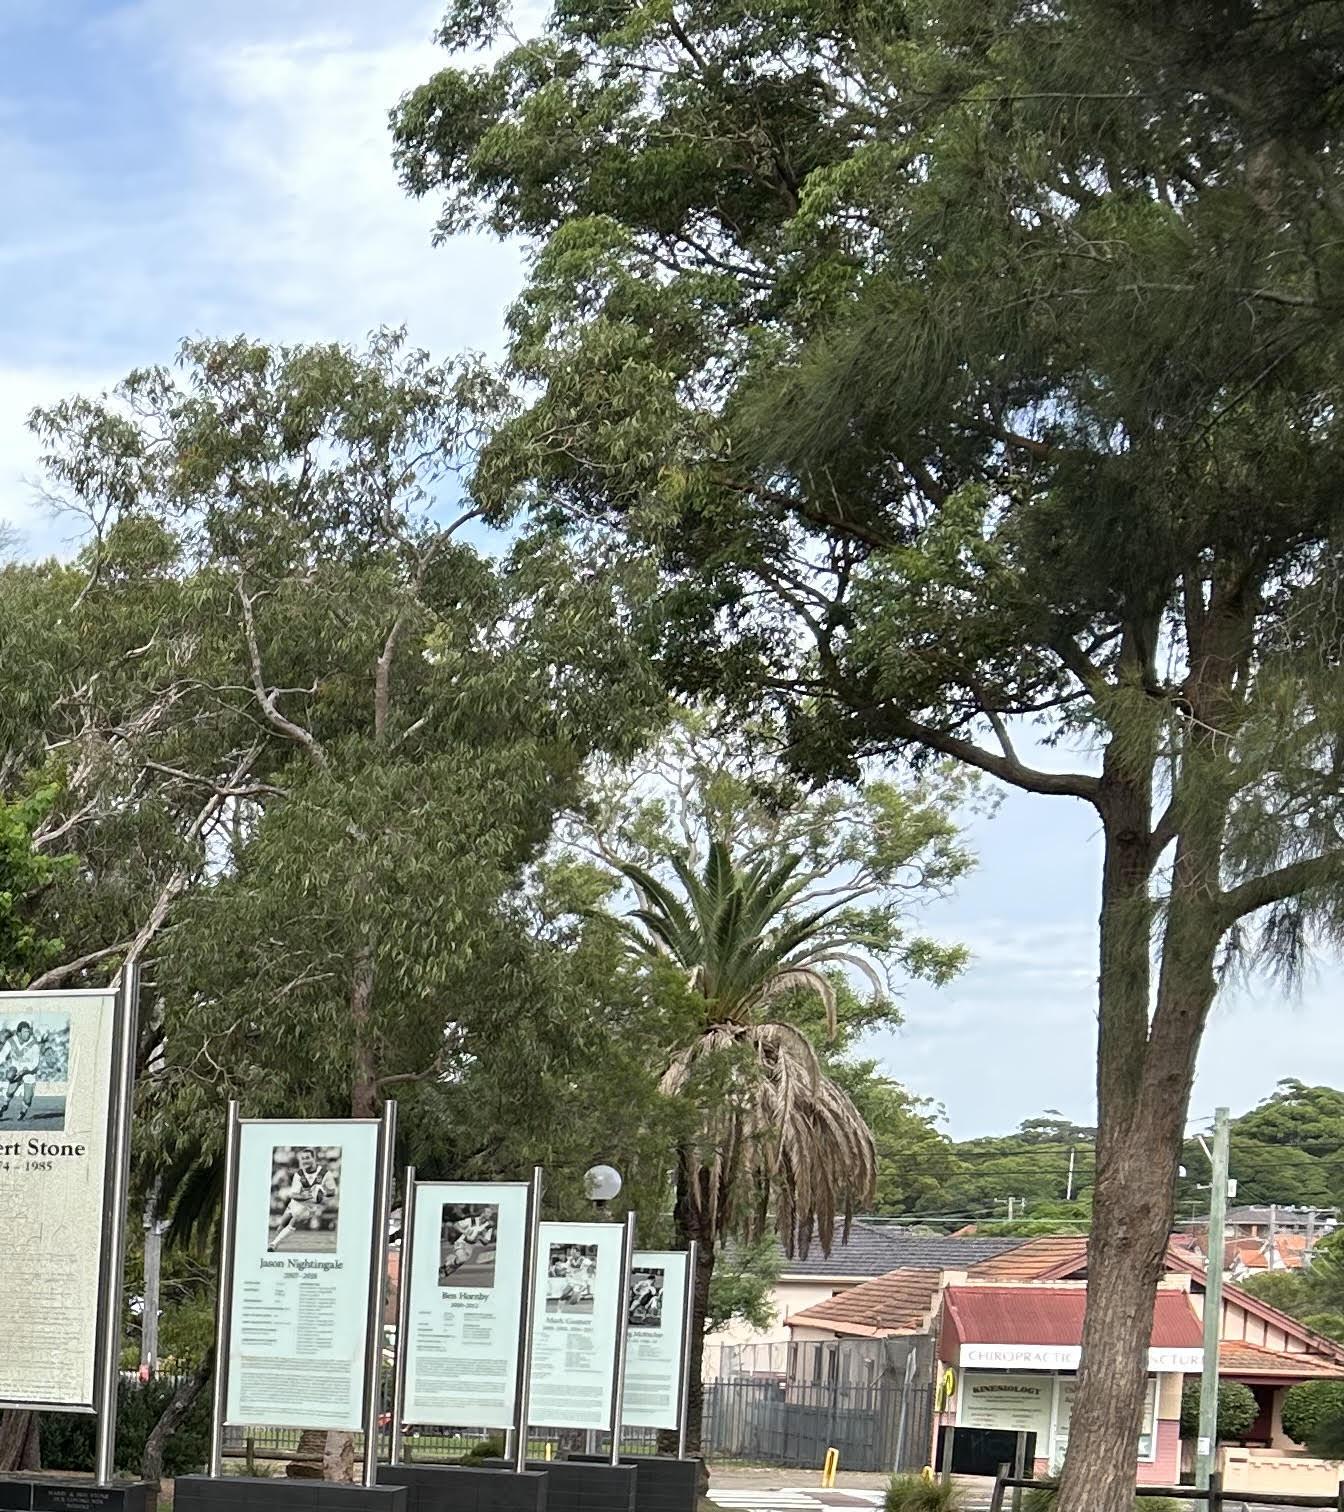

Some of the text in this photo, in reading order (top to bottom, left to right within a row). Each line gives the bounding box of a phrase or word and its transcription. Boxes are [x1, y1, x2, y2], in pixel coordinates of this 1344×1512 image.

[27, 1138, 86, 1157] Stone
[25, 1161, 53, 1173] 1985
[260, 1258, 344, 1272] Jason Nightingale
[442, 1292, 490, 1304] Ben Hornby
[968, 1351, 1072, 1364] CHIROPRACTIC
[972, 1384, 1042, 1396] KINESIOLOGY
